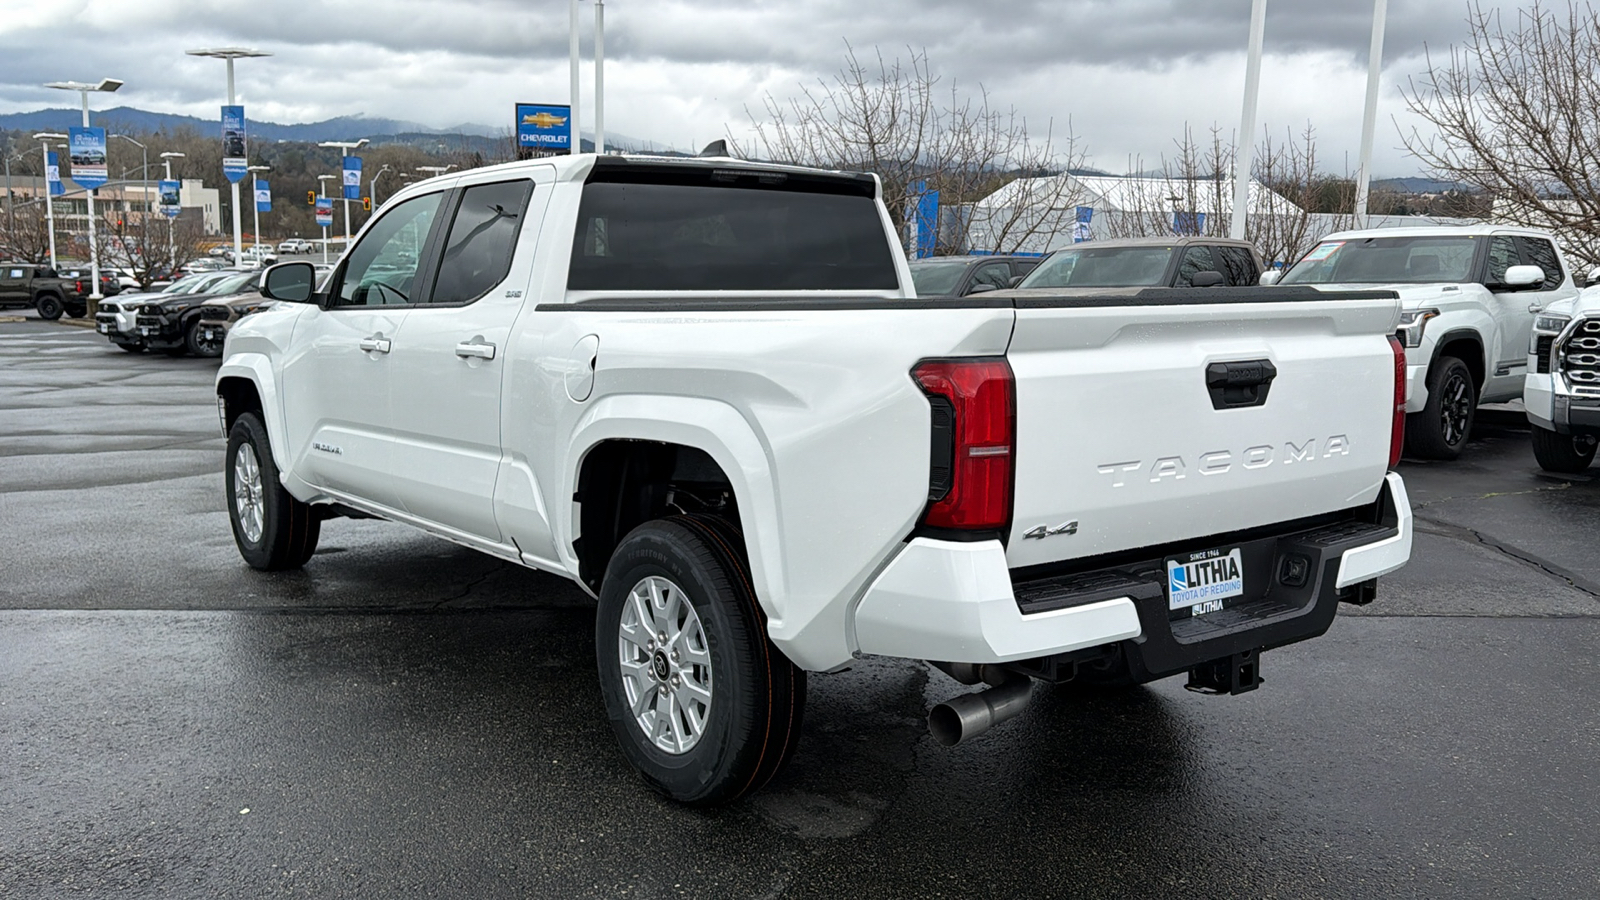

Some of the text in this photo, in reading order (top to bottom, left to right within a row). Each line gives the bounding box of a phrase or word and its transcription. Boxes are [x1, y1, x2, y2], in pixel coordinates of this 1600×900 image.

[521, 134, 568, 143] CHEVROLET
[1229, 368, 1260, 379] TOYOTA
[1097, 433, 1350, 487] TACOMA
[627, 548, 668, 563] TERRITORY
[1190, 549, 1219, 561] SINCE 1946
[1186, 557, 1240, 588] LITHIA
[1172, 580, 1241, 603] TOYOTA OF REDDING
[1200, 599, 1223, 614] LITHIA
